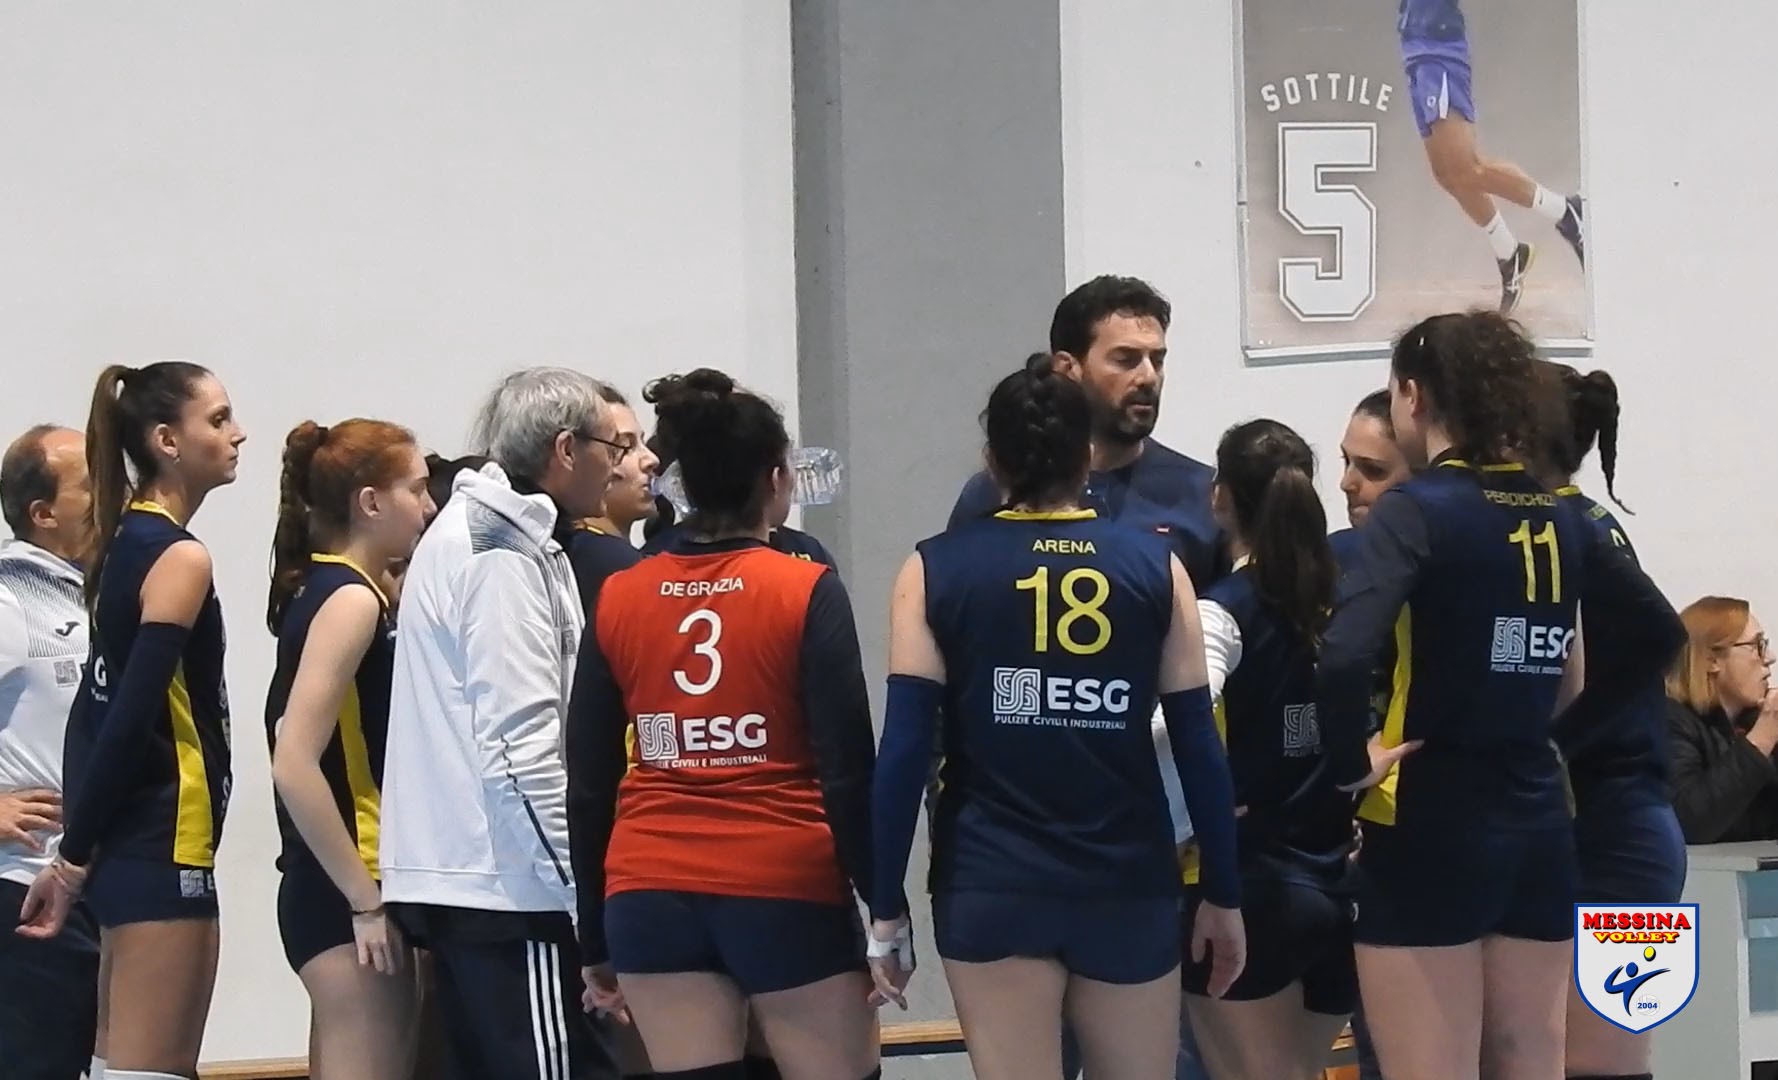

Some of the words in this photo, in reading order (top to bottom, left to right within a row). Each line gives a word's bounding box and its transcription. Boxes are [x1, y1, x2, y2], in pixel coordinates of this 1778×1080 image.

[1261, 73, 1392, 112] SOTTILE
[1278, 122, 1376, 321] 5
[1032, 539, 1097, 554] ARENA
[1508, 519, 1561, 603] 11
[660, 581, 685, 597] DE
[687, 577, 744, 597] GRAZIA
[1016, 566, 1112, 655] 18
[673, 608, 723, 696] 3
[1047, 677, 1131, 713] ESG
[682, 713, 768, 751] ESG
[994, 715, 1030, 725] PULIZIE
[709, 754, 767, 767] INDUSTRIALI
